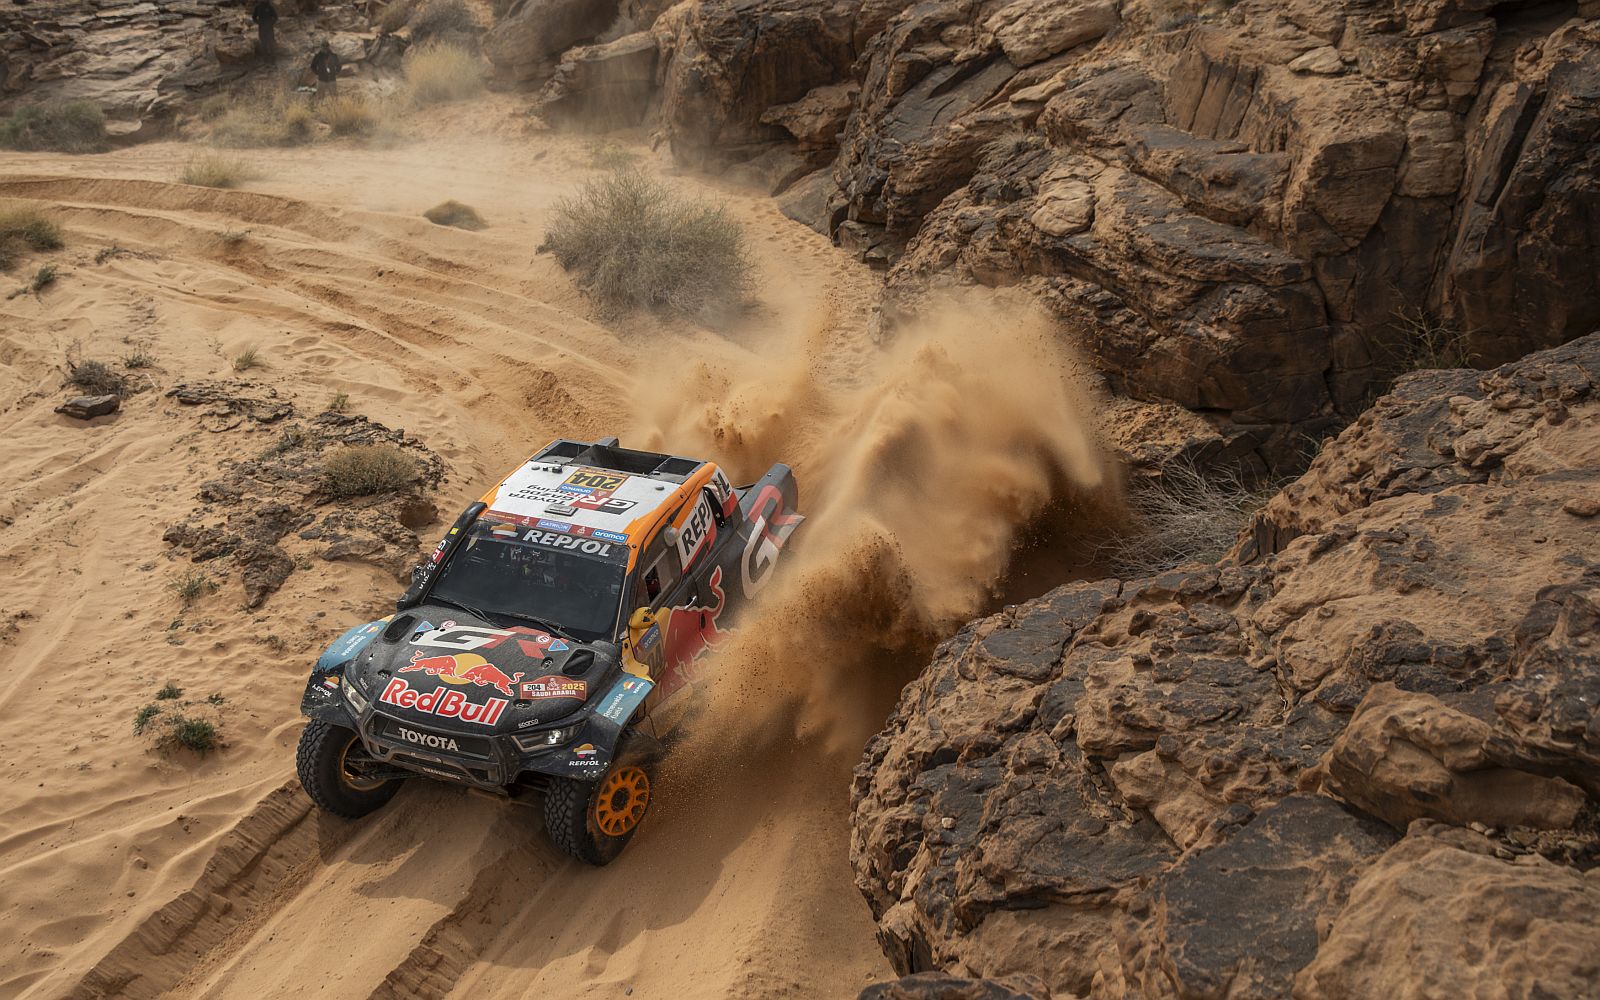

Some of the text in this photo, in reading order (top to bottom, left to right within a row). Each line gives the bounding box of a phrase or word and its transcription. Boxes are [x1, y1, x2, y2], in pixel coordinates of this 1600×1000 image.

[570, 472, 624, 489] 204
[508, 493, 566, 506] TOYOTA
[519, 489, 574, 501] GAZOO
[540, 521, 569, 531] CATRION
[682, 472, 731, 556] REPSL
[522, 529, 611, 558] REPSOL
[741, 485, 806, 600] GR
[409, 626, 569, 660] GR
[562, 683, 585, 691] 2025
[379, 677, 509, 727] Red Bull
[398, 727, 459, 752] TOYOTA
